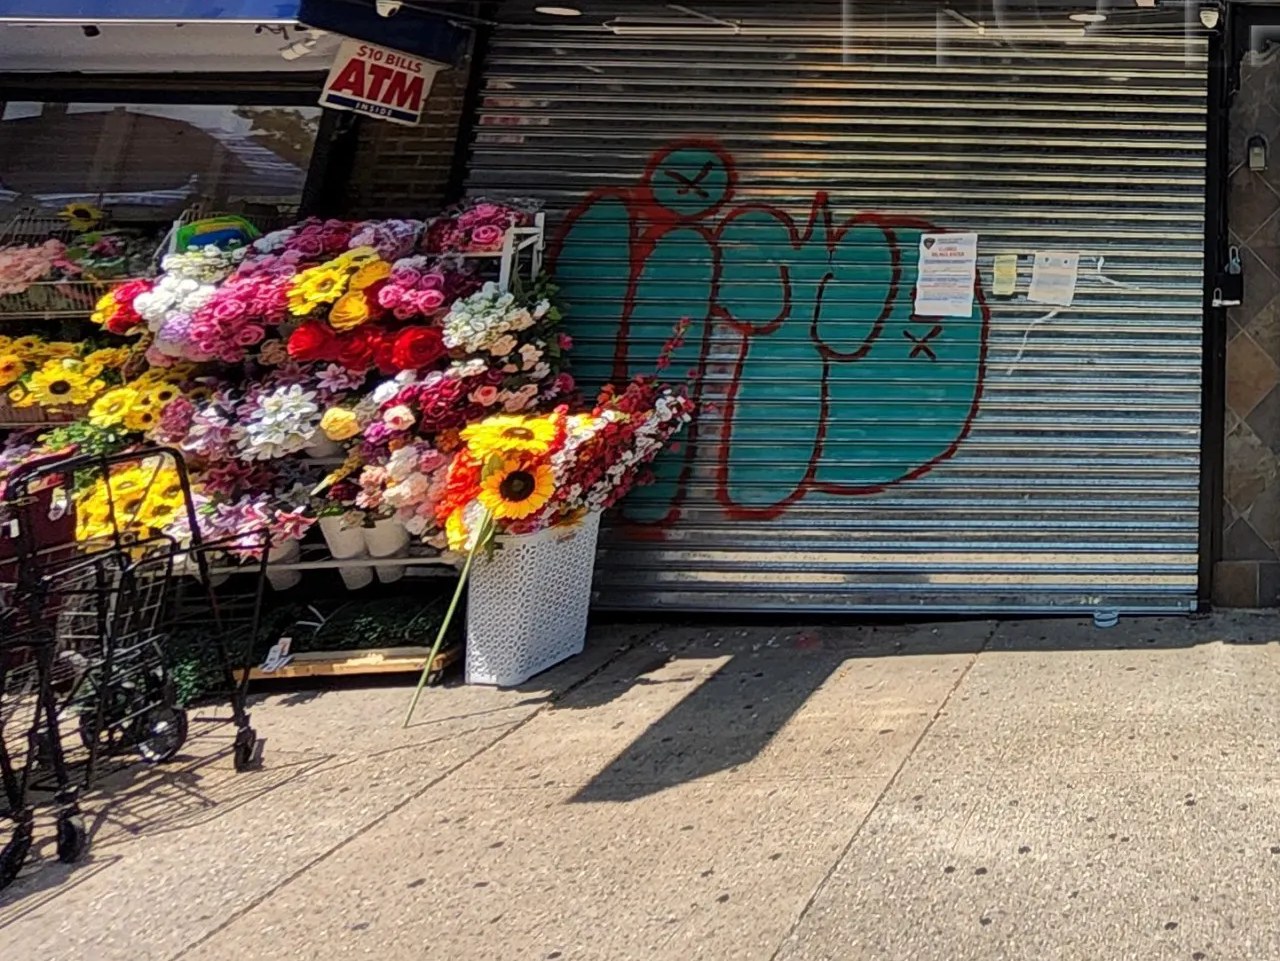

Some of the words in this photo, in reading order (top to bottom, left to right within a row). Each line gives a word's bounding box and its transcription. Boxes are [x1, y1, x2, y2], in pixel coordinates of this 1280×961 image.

[356, 45, 384, 61] $10
[385, 54, 423, 73] BILLS
[328, 58, 425, 111] ATM
[356, 102, 393, 117] INSIDE
